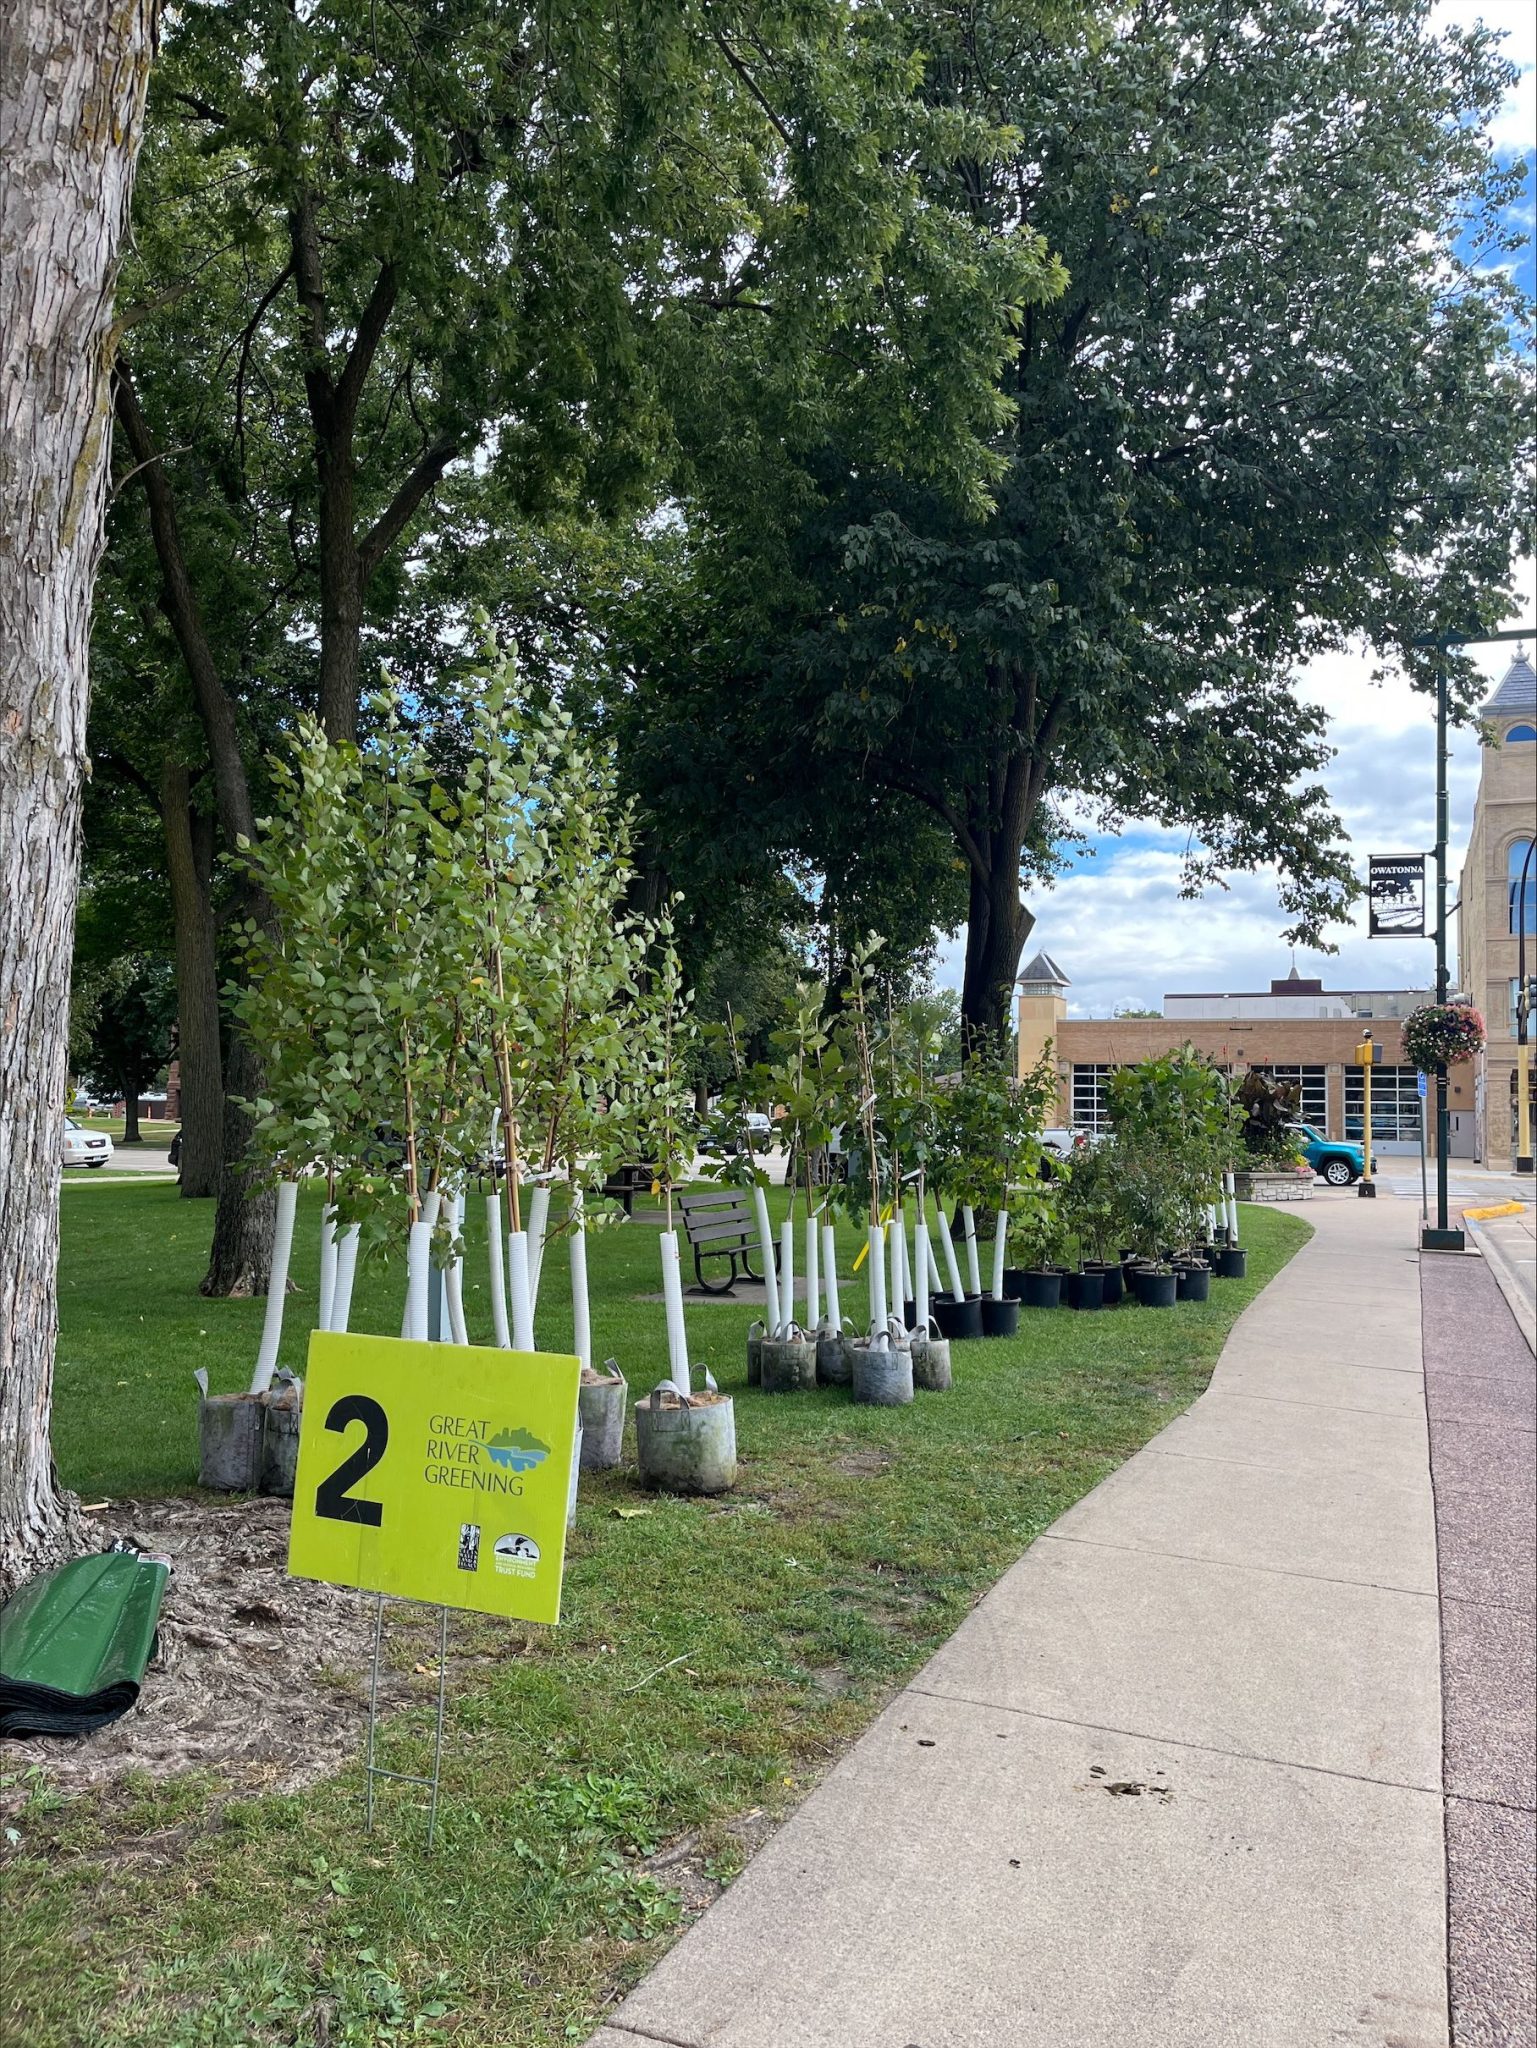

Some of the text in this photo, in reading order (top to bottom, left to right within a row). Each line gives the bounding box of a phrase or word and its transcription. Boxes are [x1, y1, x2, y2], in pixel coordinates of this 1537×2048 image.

[1370, 866, 1424, 874] OWATONNA
[429, 1415, 491, 1439] GREAT
[315, 1395, 389, 1527] 2
[427, 1440, 480, 1465] RIVER
[424, 1465, 524, 1496] GREENING
[495, 1566, 516, 1576] TRUST
[516, 1569, 536, 1579] FUND
